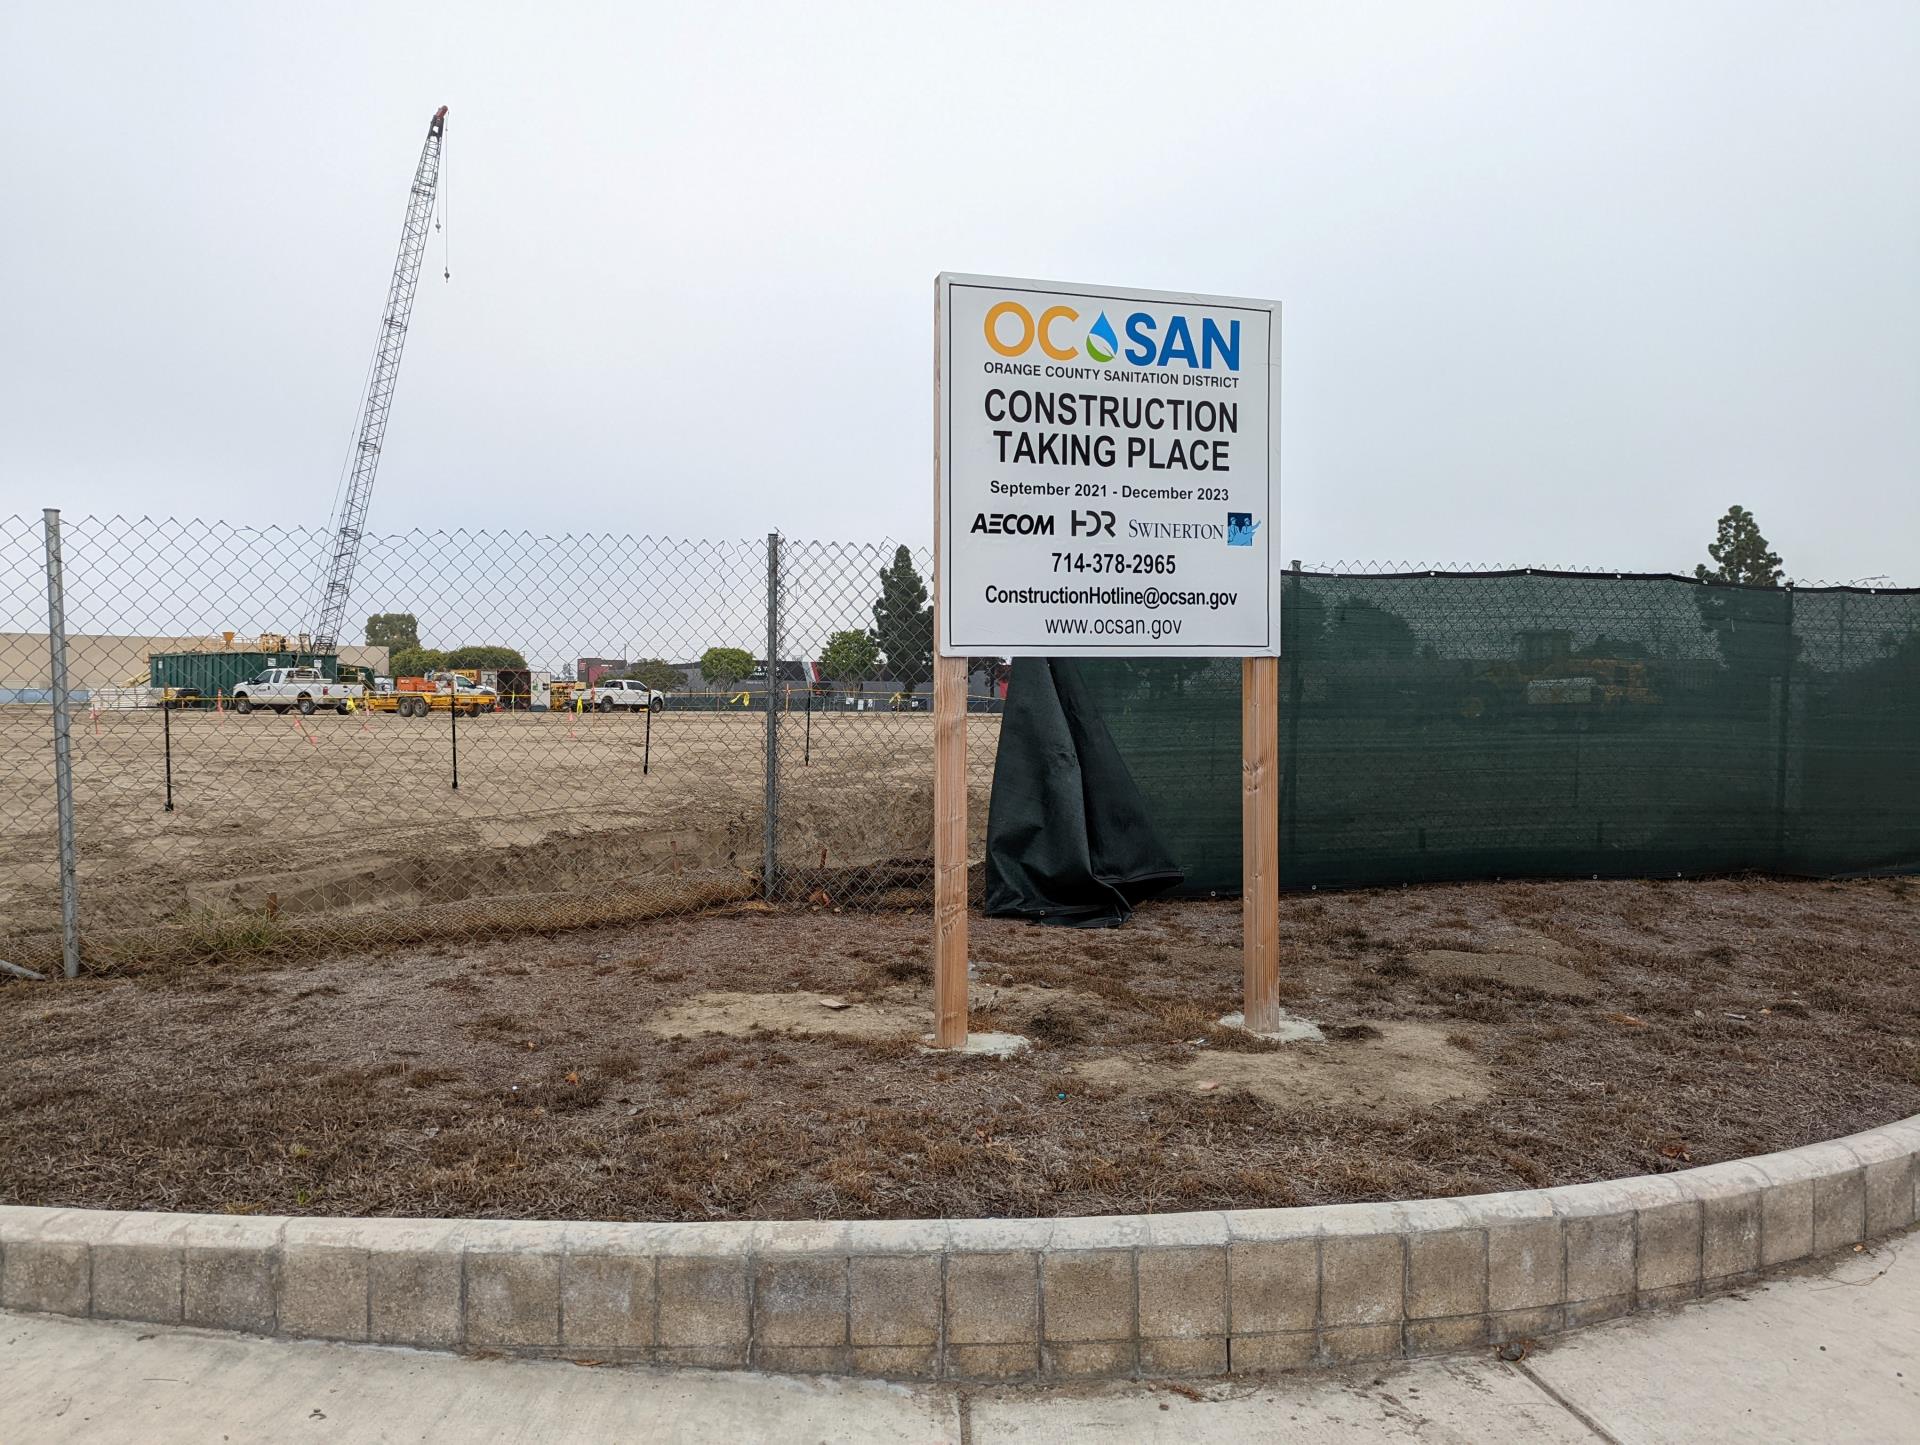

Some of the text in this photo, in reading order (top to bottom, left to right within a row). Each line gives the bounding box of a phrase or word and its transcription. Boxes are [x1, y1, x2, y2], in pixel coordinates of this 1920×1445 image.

[984, 301, 1240, 371] OC SAN
[984, 362, 1239, 388] ORANGE COUNTY SANITATION DISTRICT
[985, 389, 1238, 433] CONSTRUCTION
[993, 430, 1230, 471] TAKING PLACE
[990, 480, 1070, 499] September
[1075, 485, 1106, 497] 2021
[1122, 486, 1193, 500] December
[1197, 488, 1228, 501] 2023
[971, 513, 1054, 535] AECOM
[1072, 510, 1116, 537] HDR
[1129, 520, 1223, 539] SWINERTON
[1052, 552, 1176, 574] 714-378-2965
[985, 585, 1237, 609] ConstructionHotline@ocsan.gov
[1045, 617, 1182, 639] www.ocsan.gov
